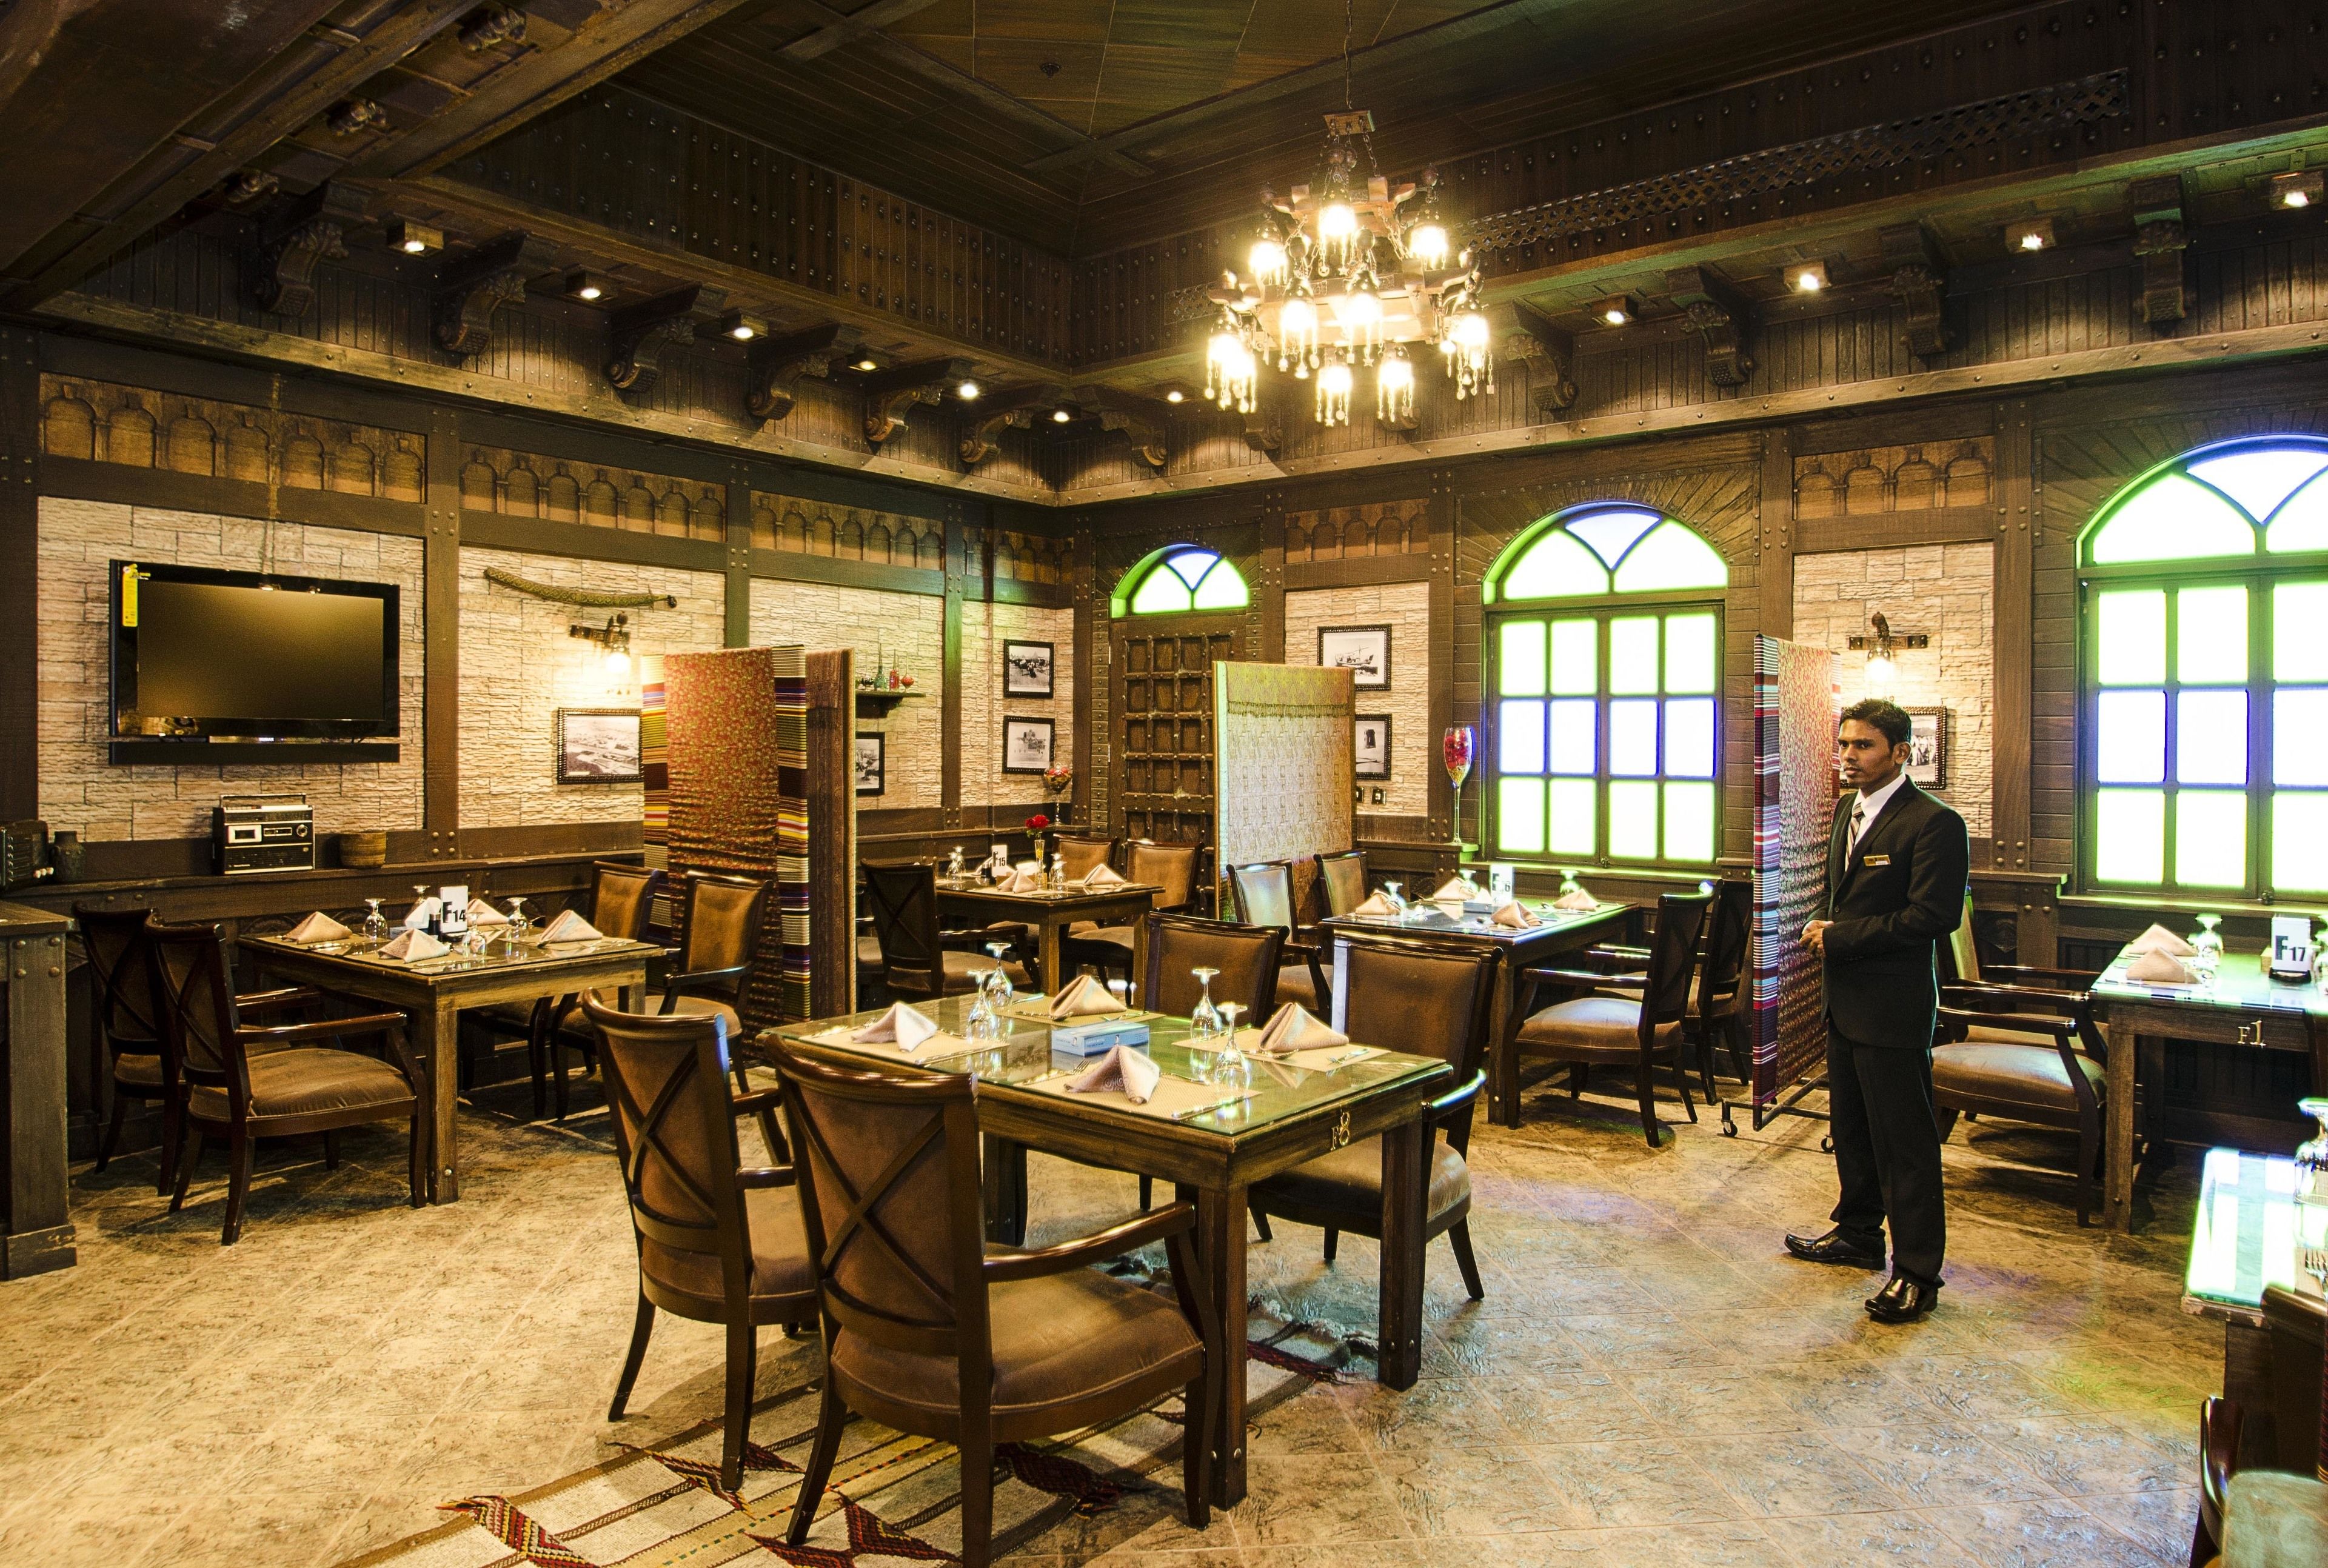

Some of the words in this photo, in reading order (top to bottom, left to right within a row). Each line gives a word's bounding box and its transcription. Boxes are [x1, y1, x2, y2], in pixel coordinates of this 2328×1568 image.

[993, 851, 1006, 867] F15
[1492, 873, 1511, 892] F6
[443, 901, 466, 923] F14
[2275, 935, 2306, 961] F17
[2237, 1020, 2267, 1047] F1
[1330, 1112, 1350, 1151] F8
